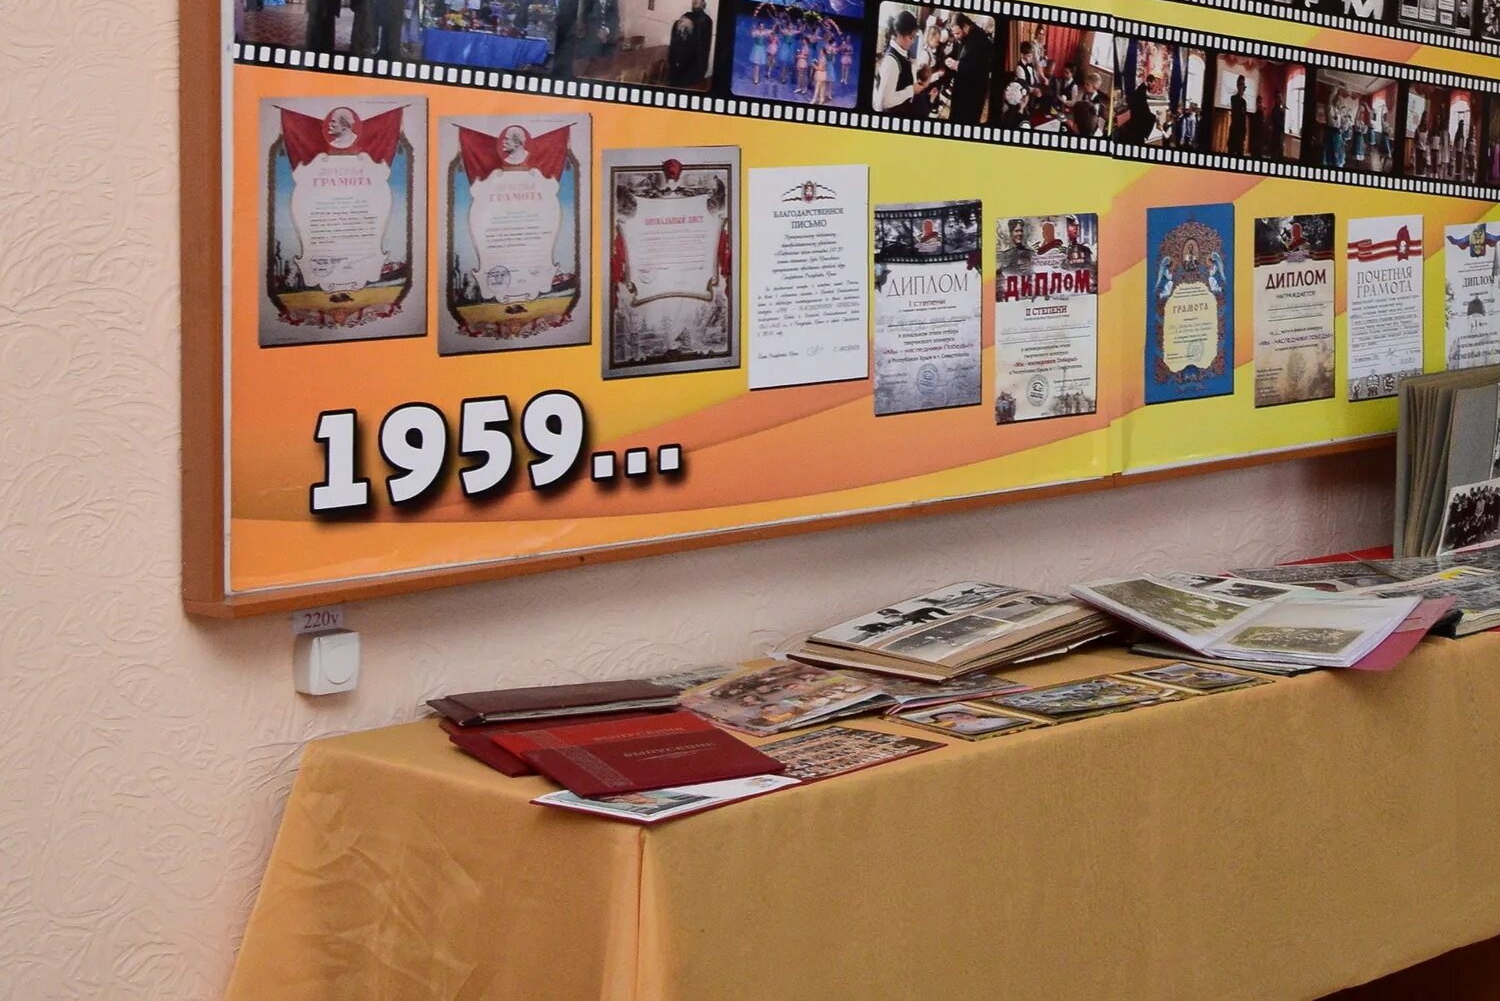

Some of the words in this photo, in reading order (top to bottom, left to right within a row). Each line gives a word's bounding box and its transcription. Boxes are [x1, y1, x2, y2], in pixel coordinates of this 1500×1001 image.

[792, 219, 827, 229] ПИСЬМО
[887, 273, 968, 297] ДИПЛОМ
[1265, 269, 1326, 290] ДИПЛОМ
[1357, 266, 1412, 285] ПОЧЕТНАЯ
[1003, 270, 1091, 302] ДИПЛОМ
[1357, 280, 1412, 298] ГРАМОТА
[1173, 303, 1208, 314] ГРАМОТА
[303, 610, 340, 629] 220v
